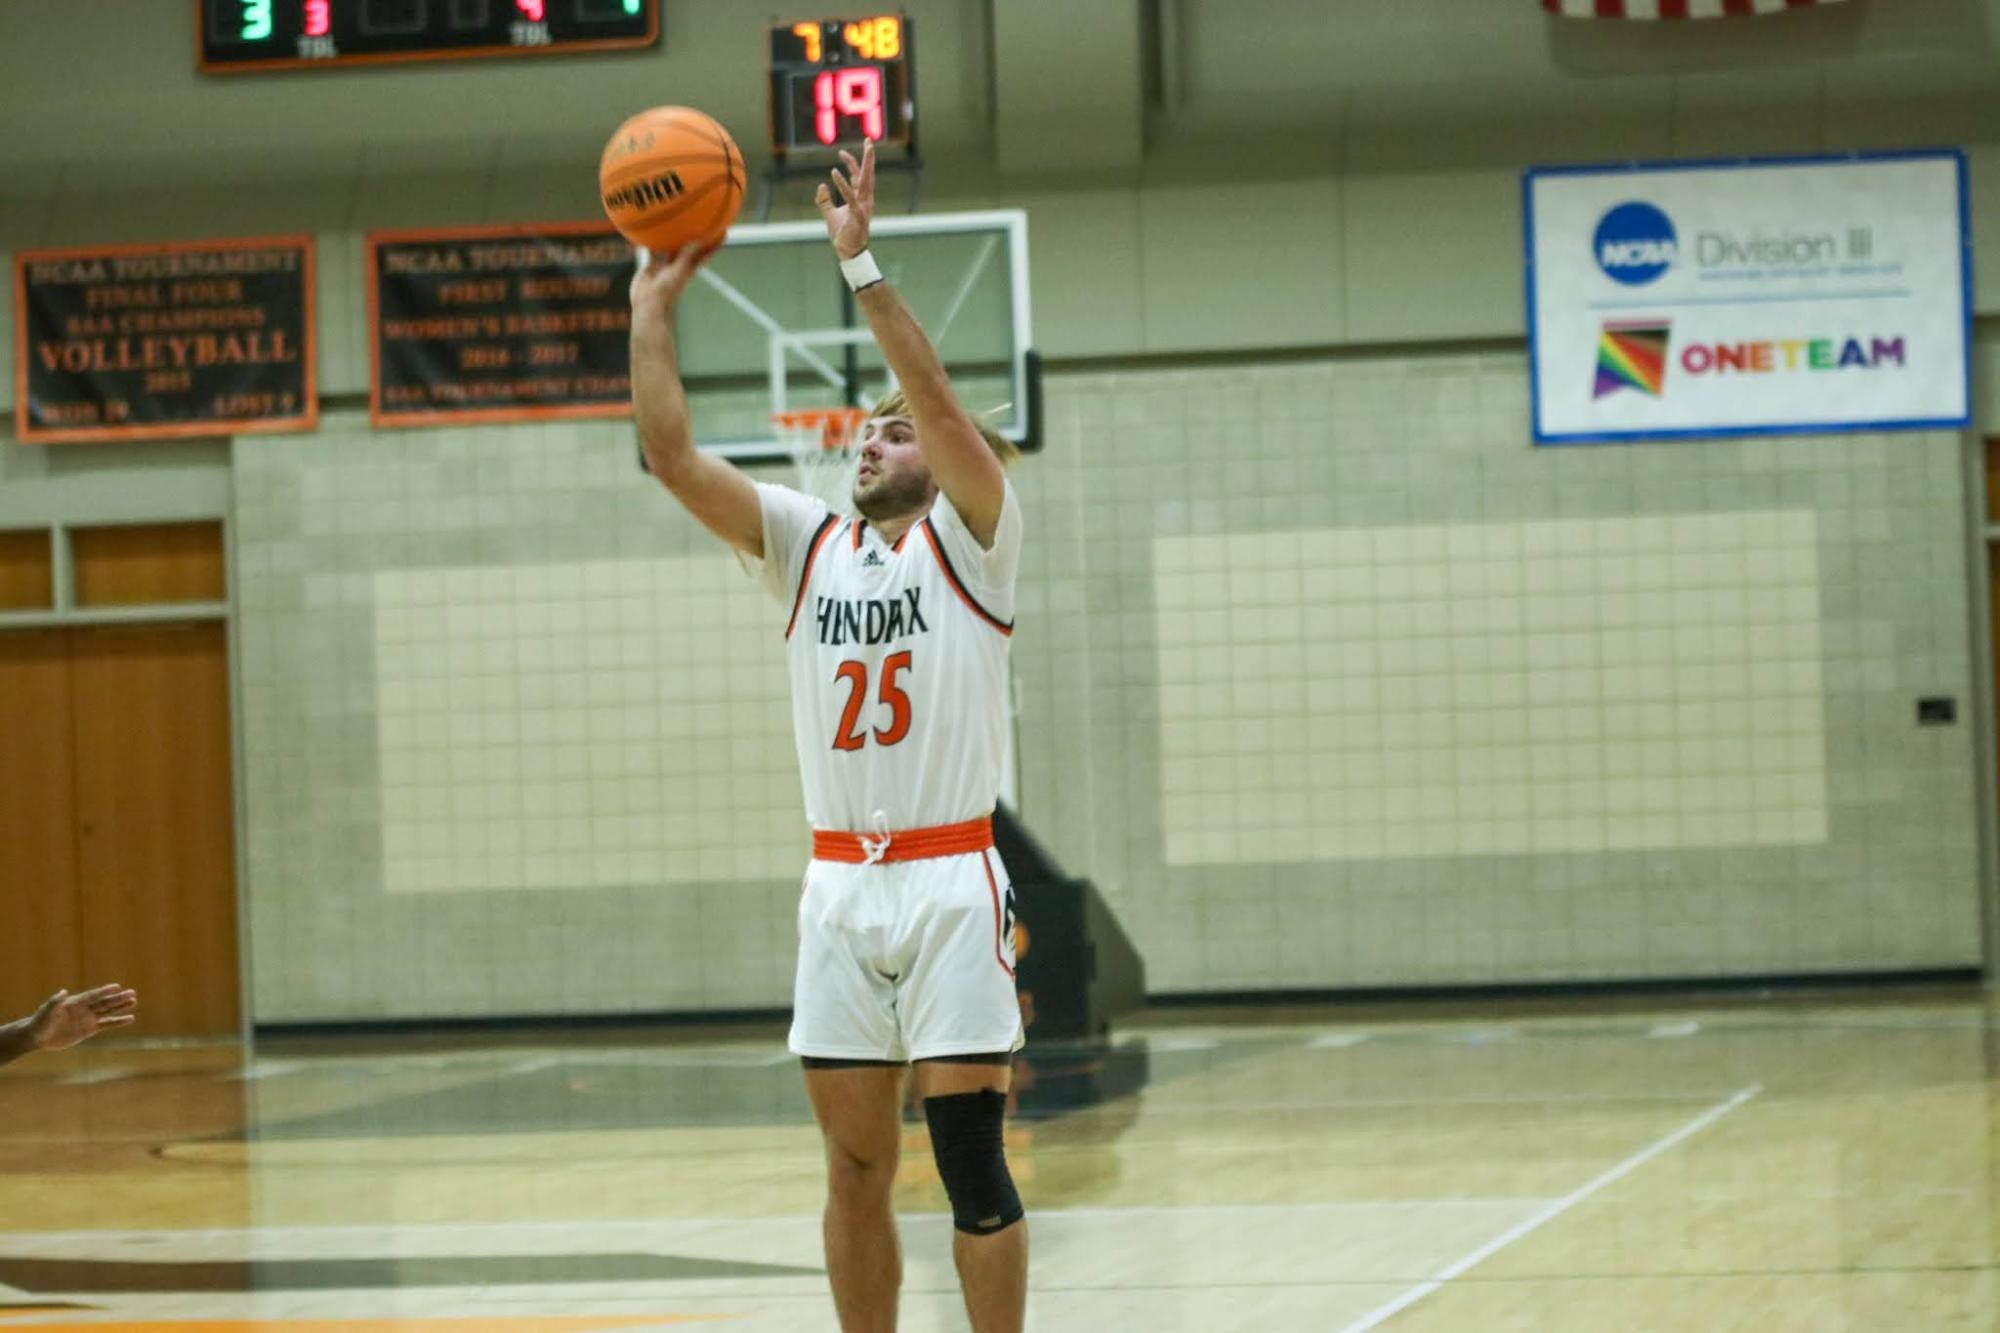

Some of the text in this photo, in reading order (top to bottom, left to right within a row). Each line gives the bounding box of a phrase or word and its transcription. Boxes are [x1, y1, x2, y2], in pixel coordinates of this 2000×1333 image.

[813, 66, 883, 145] 19
[114, 251, 298, 280] TOURNAMENT
[1602, 237, 1677, 268] NCAA
[1697, 233, 1836, 267] Division
[38, 328, 298, 373] VOLLEYBALL
[832, 650, 913, 752] 25
